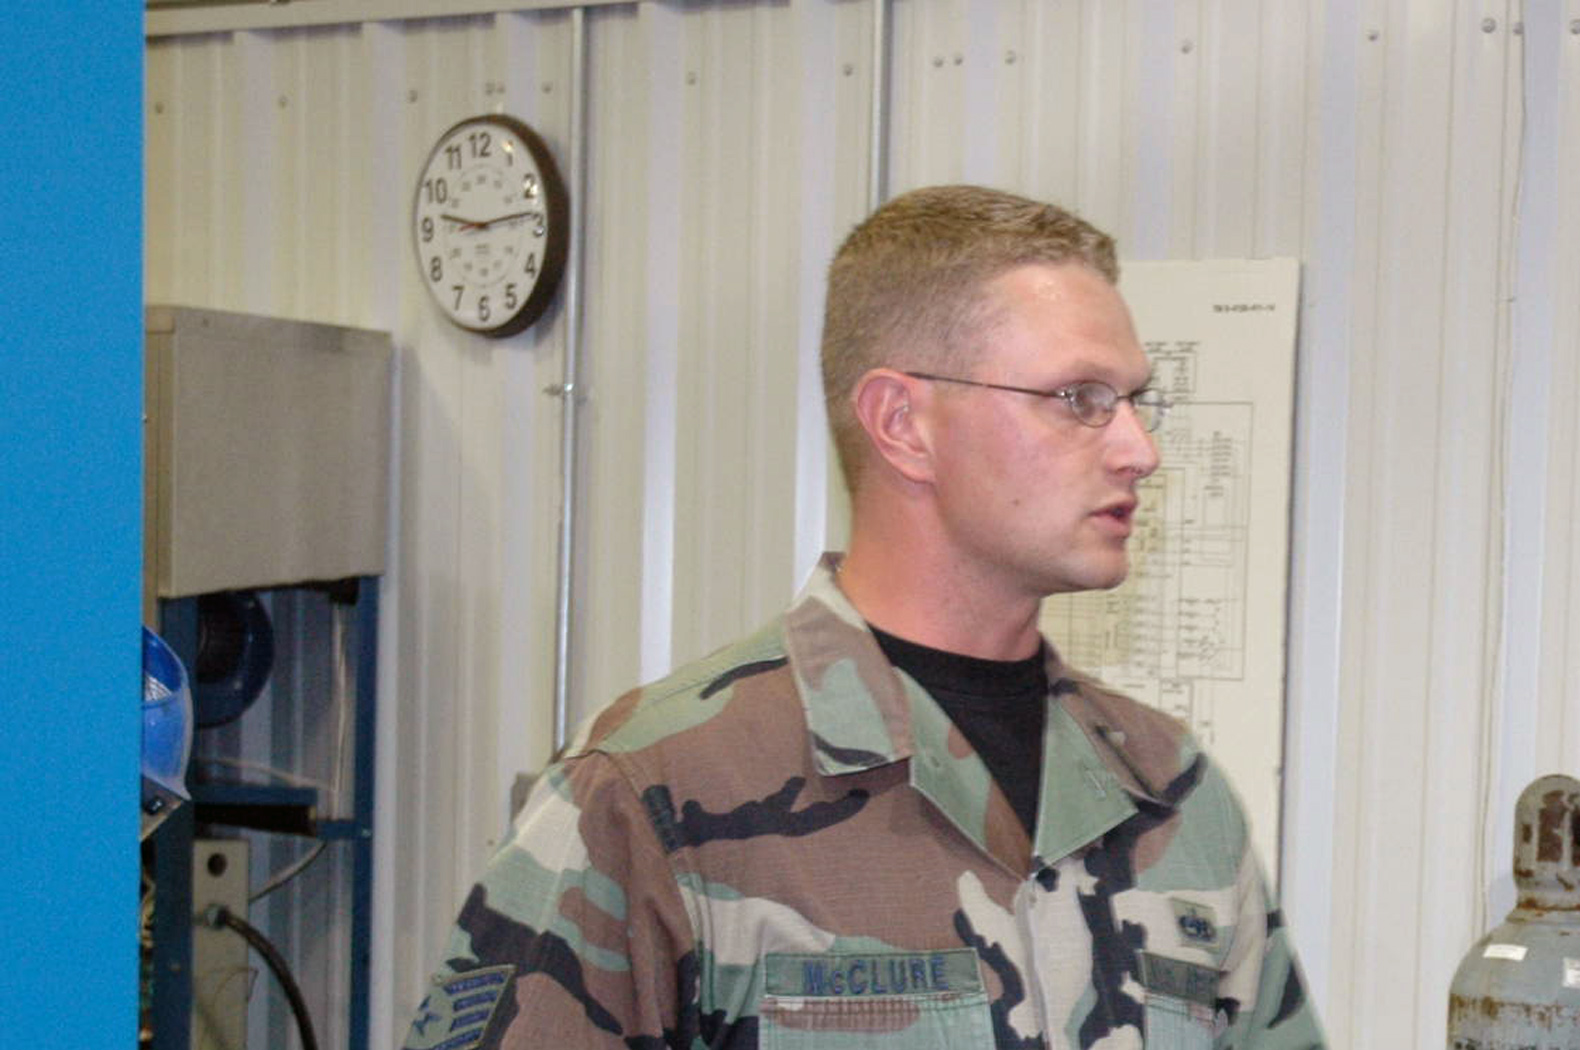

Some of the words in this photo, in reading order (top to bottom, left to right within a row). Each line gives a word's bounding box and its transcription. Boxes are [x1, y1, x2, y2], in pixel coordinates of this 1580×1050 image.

[445, 145, 462, 170] 11
[469, 132, 492, 158] 12
[426, 178, 448, 205] 10
[523, 173, 539, 200] 2
[421, 217, 434, 243] 9
[430, 256, 443, 283] 8
[524, 252, 536, 280] 4
[452, 285, 464, 311] 7
[478, 296, 490, 322] 6
[505, 283, 518, 310] 5
[803, 955, 949, 995] McCLURE
